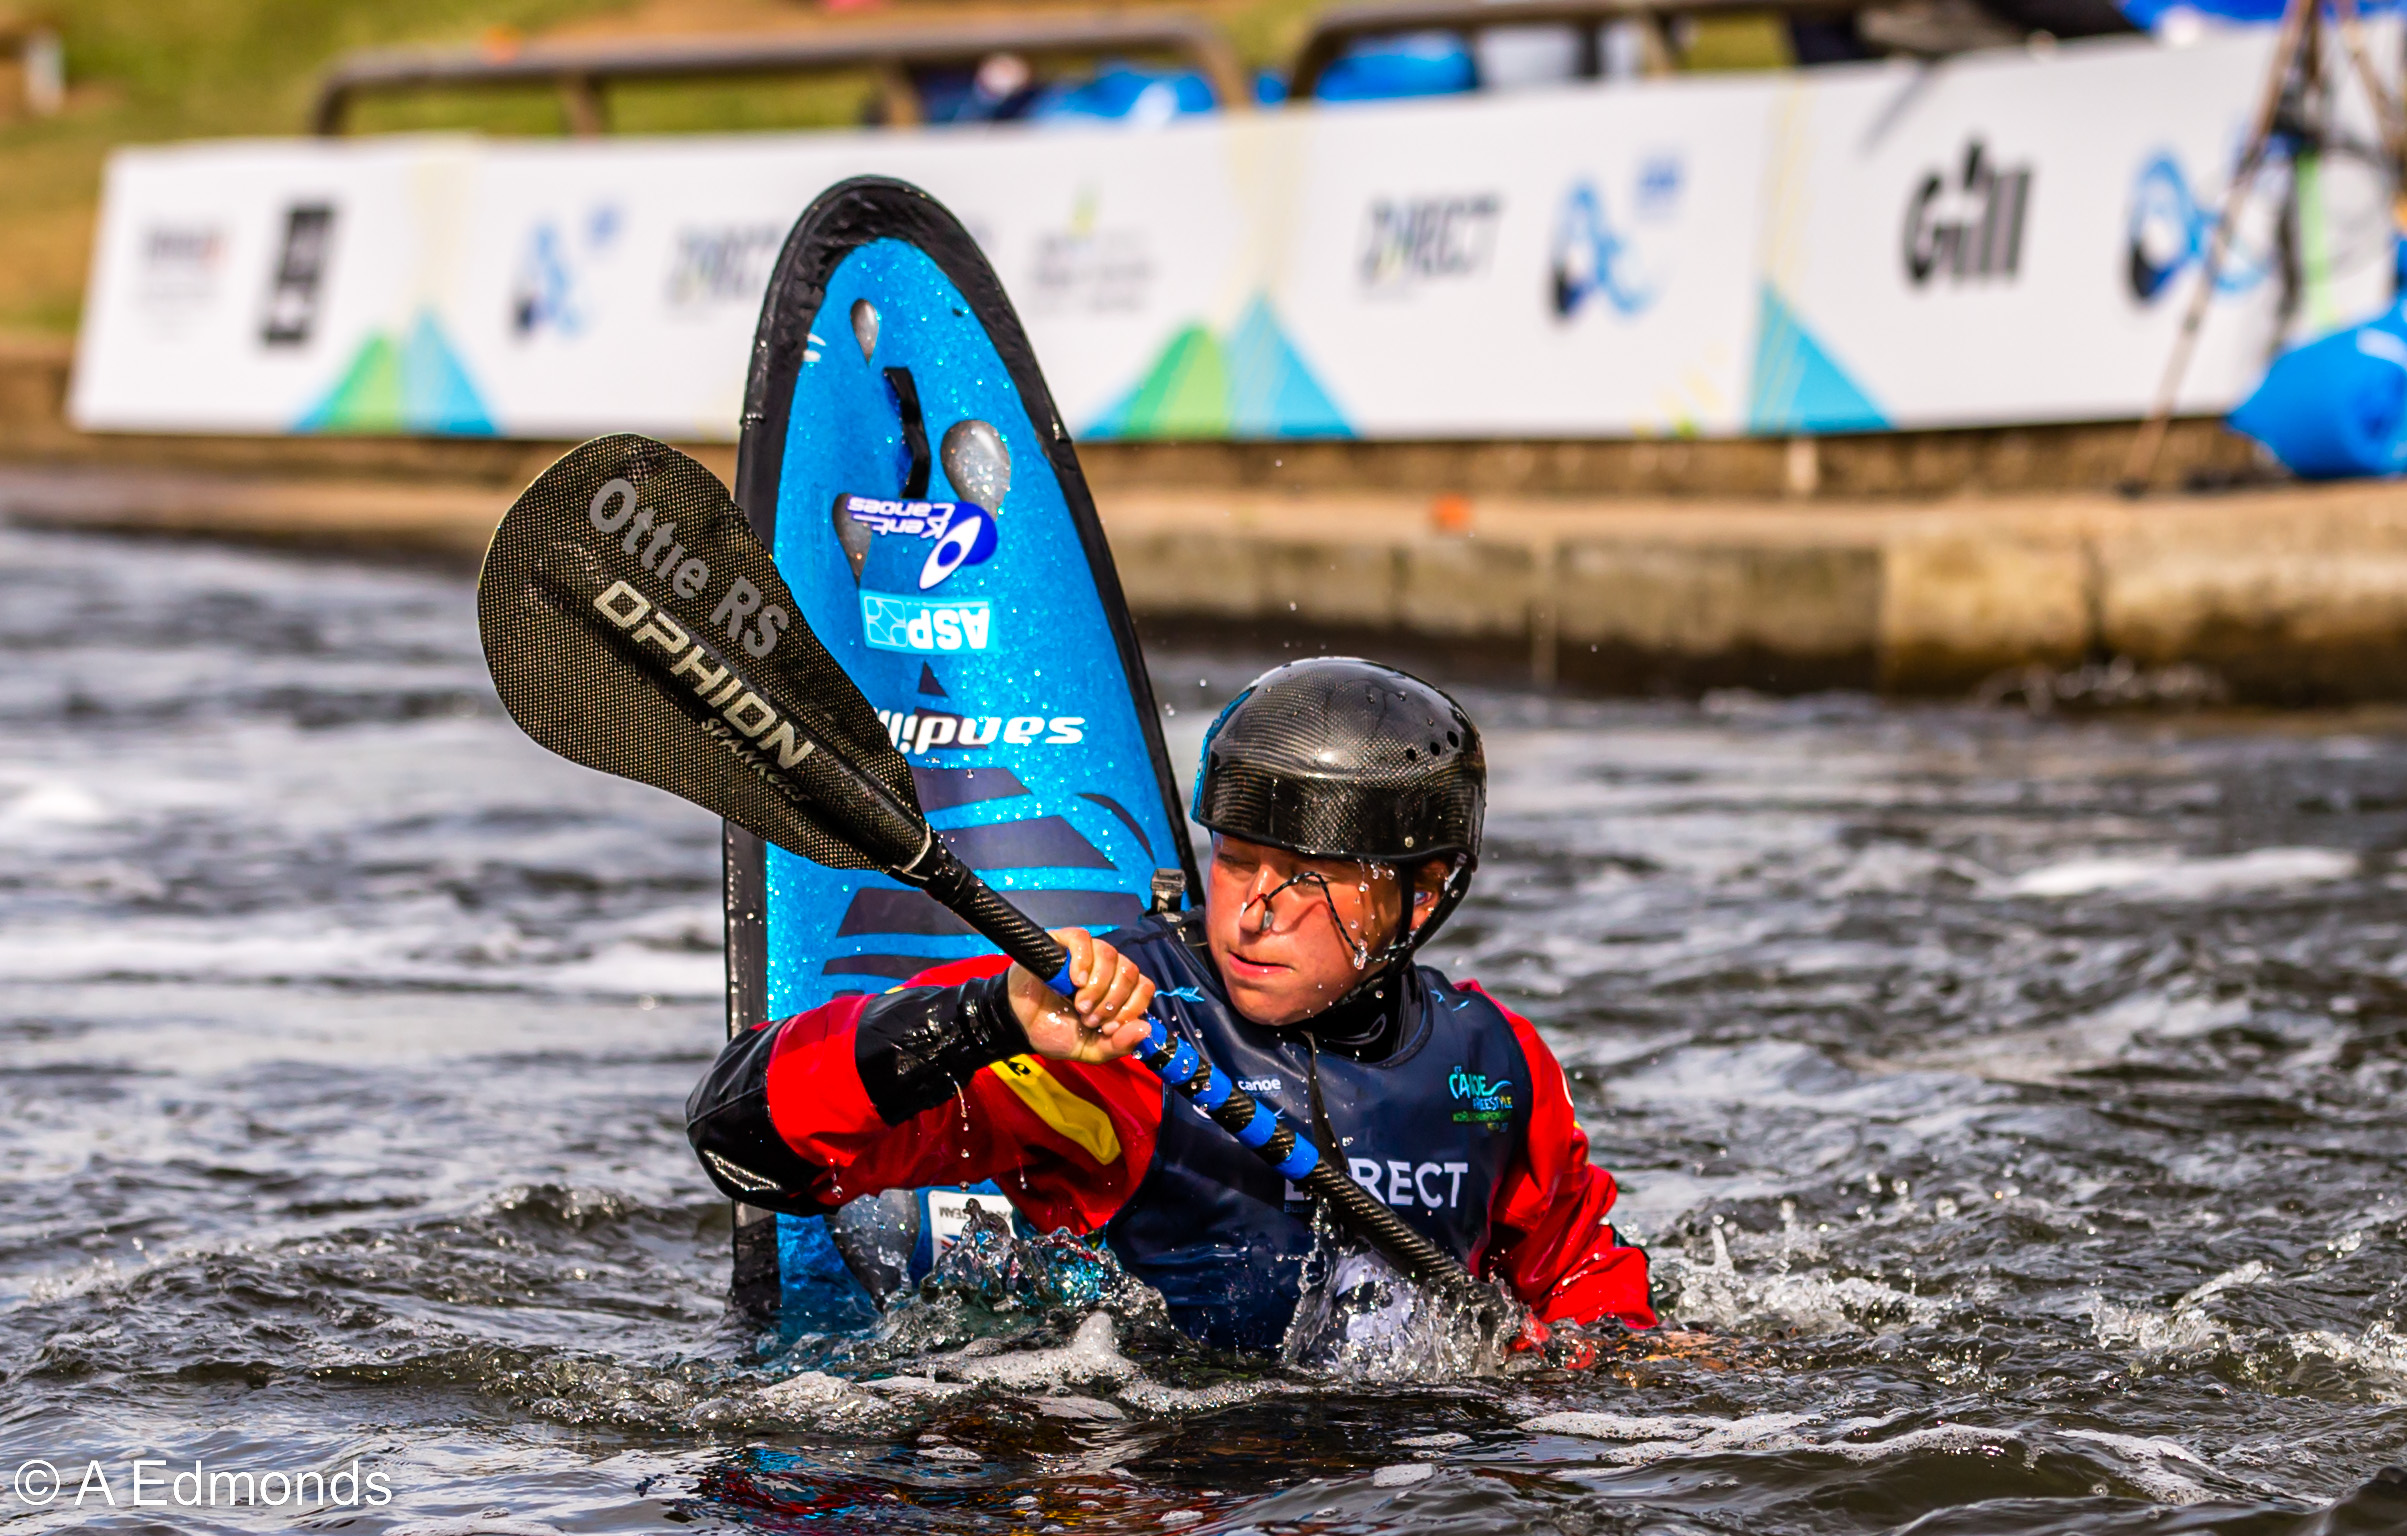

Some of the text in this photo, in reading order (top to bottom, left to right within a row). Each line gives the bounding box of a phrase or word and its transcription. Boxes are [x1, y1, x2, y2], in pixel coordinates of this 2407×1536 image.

[1903, 136, 2033, 287] Gill
[847, 496, 956, 521] Canoes
[853, 513, 949, 540] Kent
[709, 575, 789, 659] RS
[907, 608, 991, 650] ASP
[593, 580, 815, 770] OPHION
[1237, 1078, 1282, 1092] canoe
[1284, 1157, 1468, 1208] RECT
